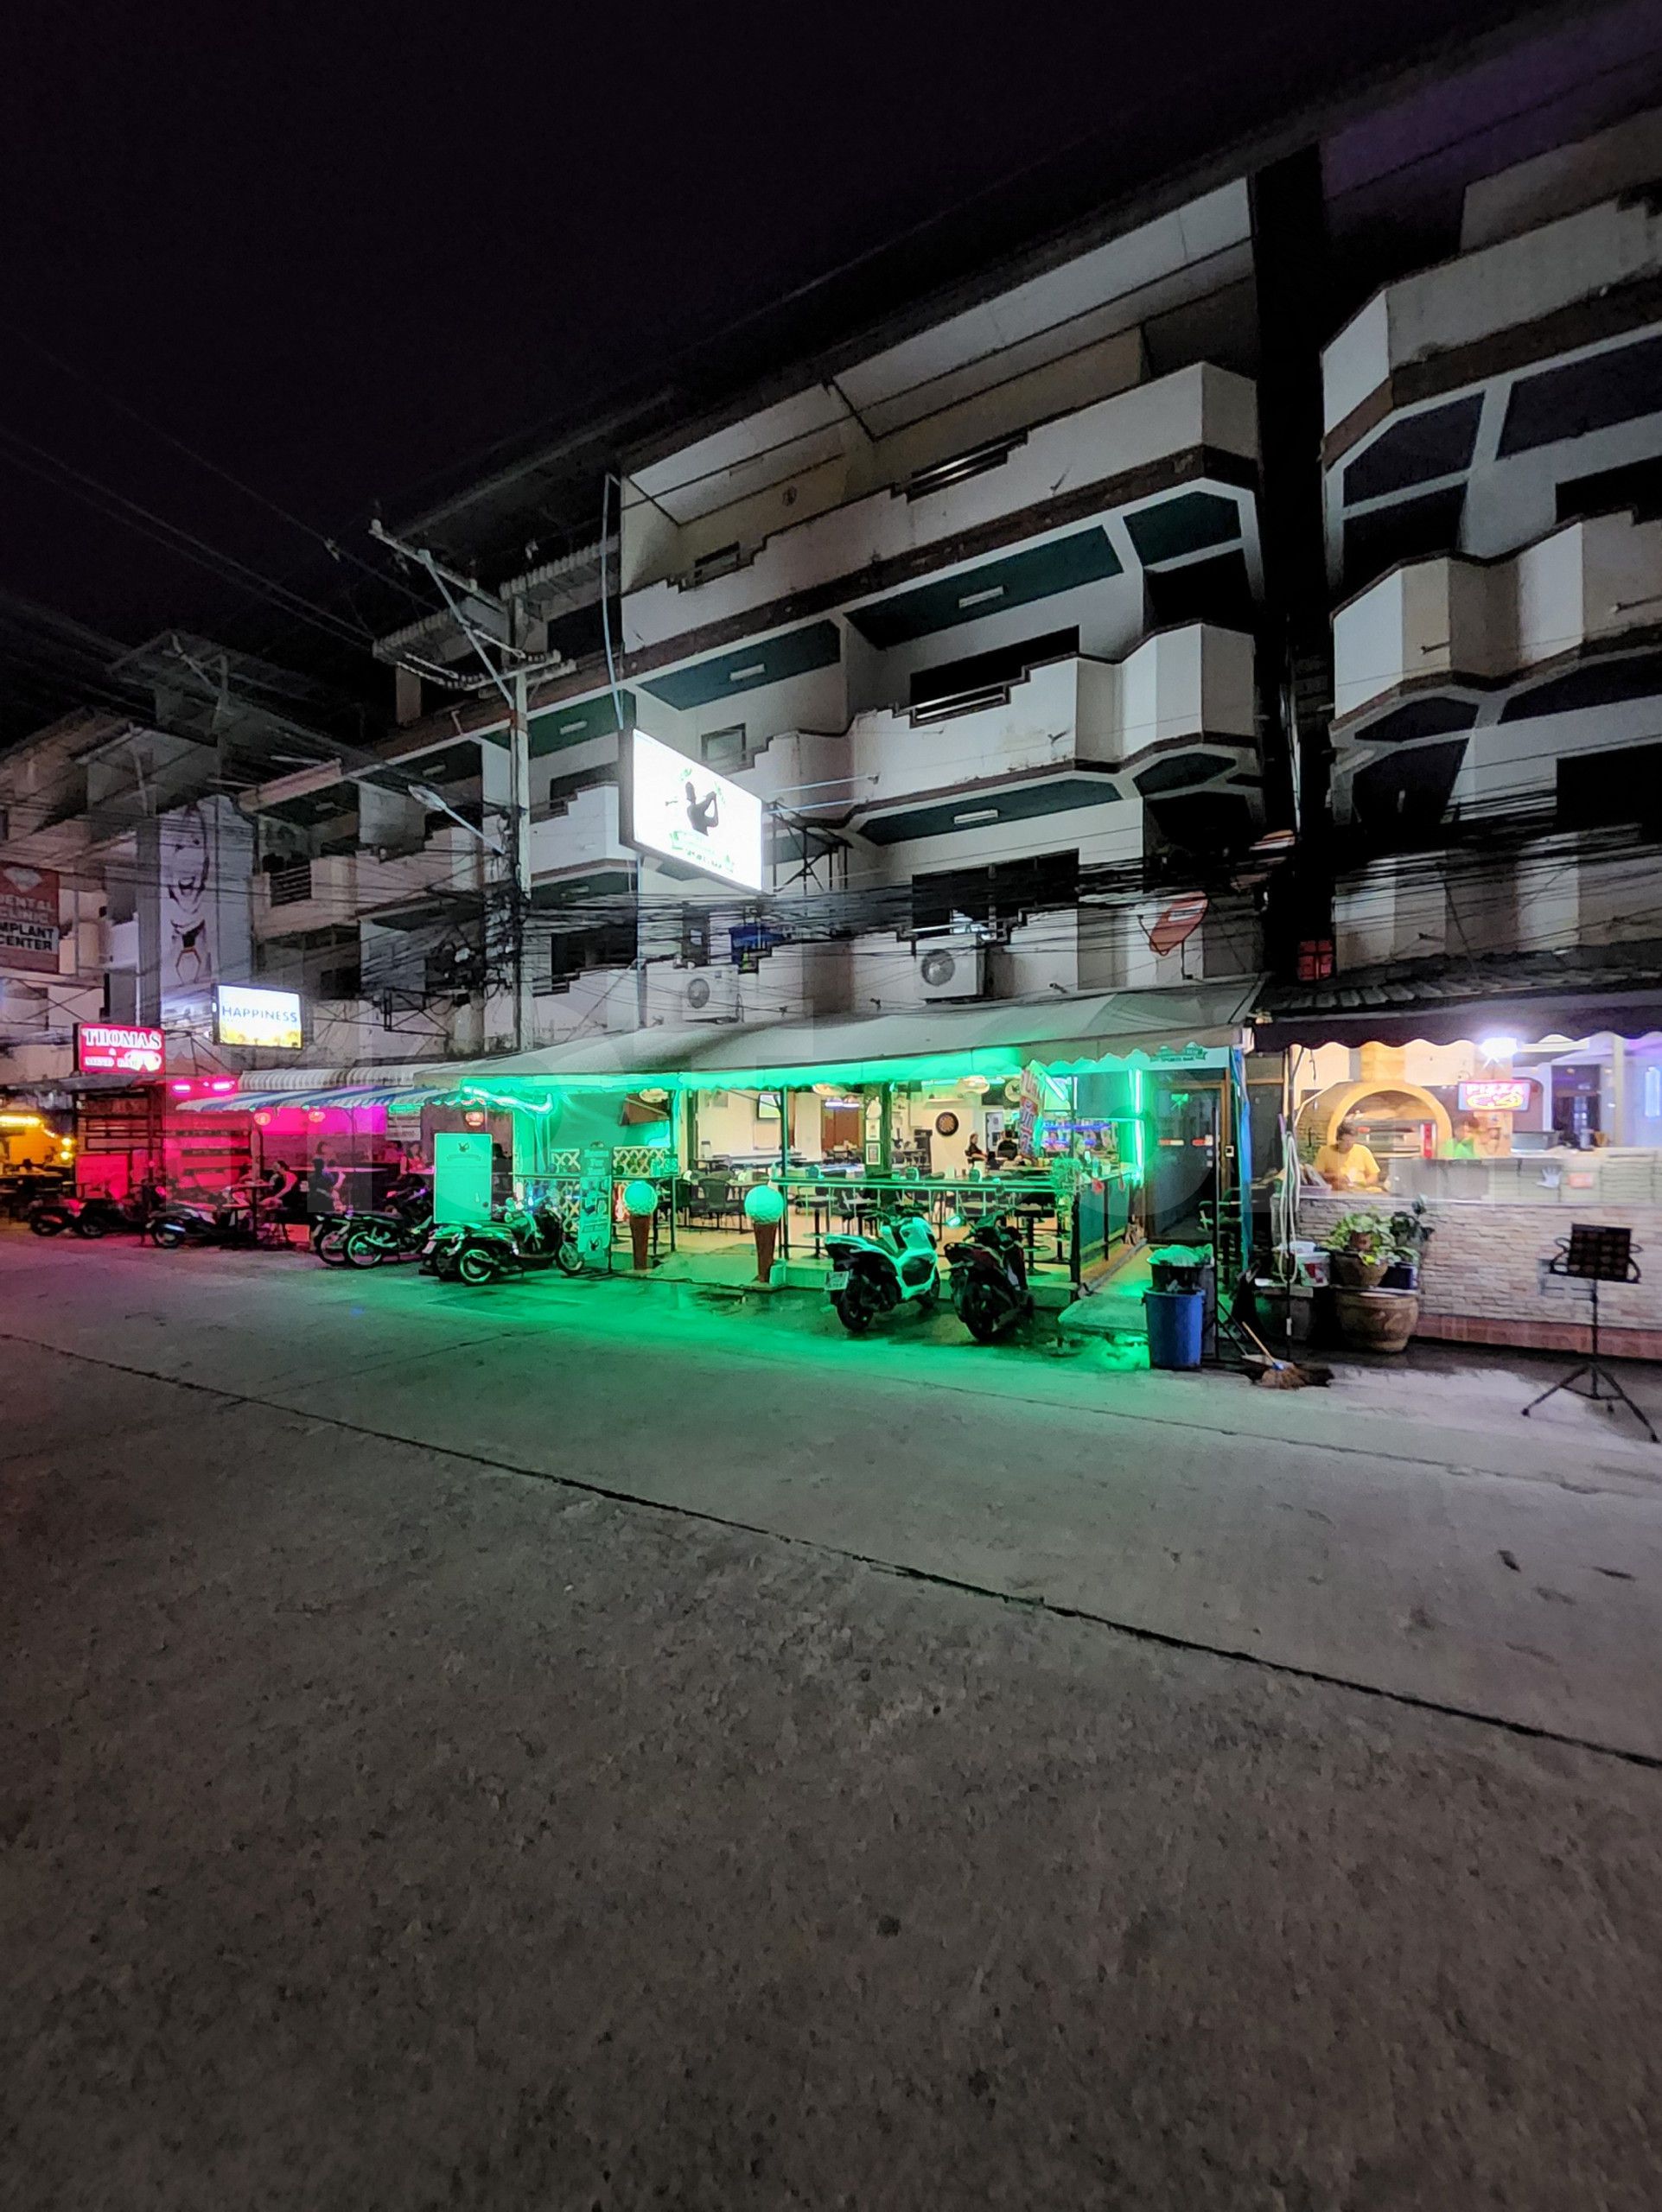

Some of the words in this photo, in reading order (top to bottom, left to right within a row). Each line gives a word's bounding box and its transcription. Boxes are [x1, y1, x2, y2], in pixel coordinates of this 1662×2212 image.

[221, 1005, 298, 1023] HAPPINESS
[82, 1027, 162, 1050] THOMAS
[1466, 1083, 1525, 1096] PIZZA
